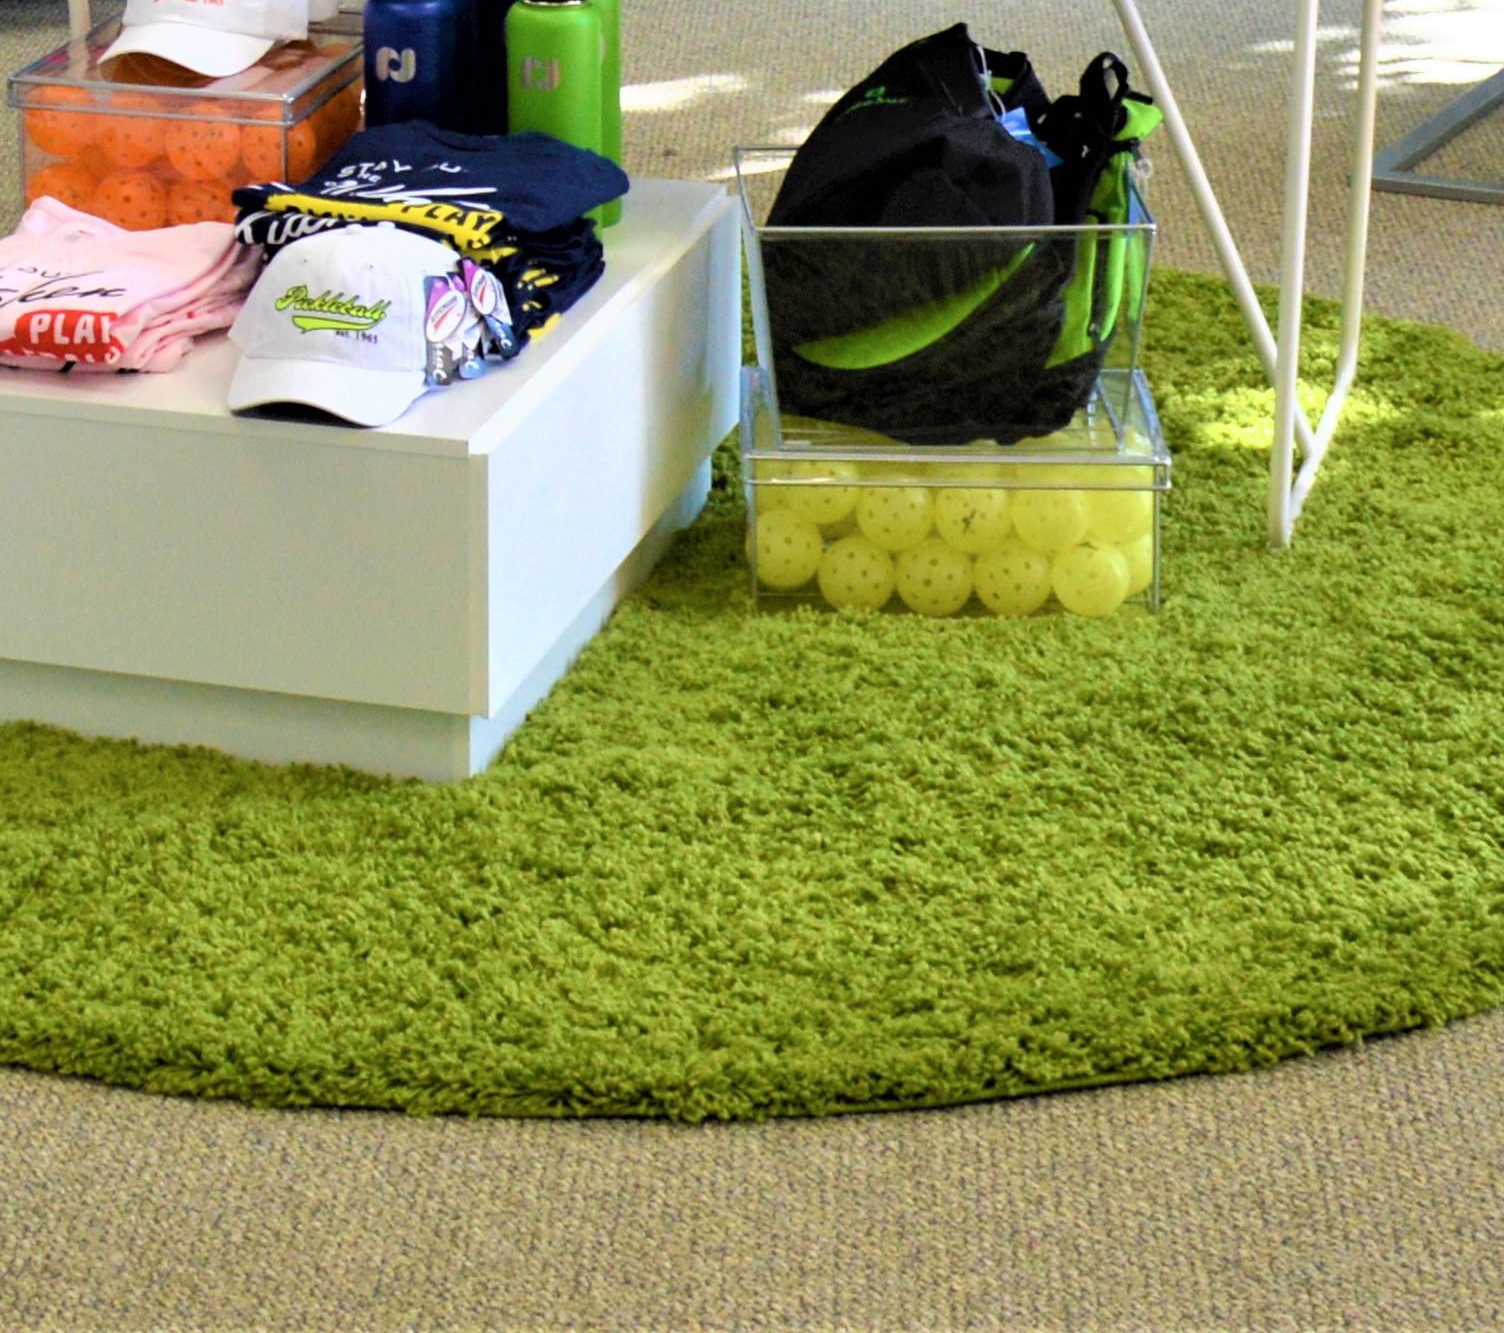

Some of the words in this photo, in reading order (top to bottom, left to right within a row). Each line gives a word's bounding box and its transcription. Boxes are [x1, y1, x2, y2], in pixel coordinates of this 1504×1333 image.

[400, 203, 497, 231] PLAY
[275, 285, 392, 321] Pickleball
[355, 331, 379, 344] 1965
